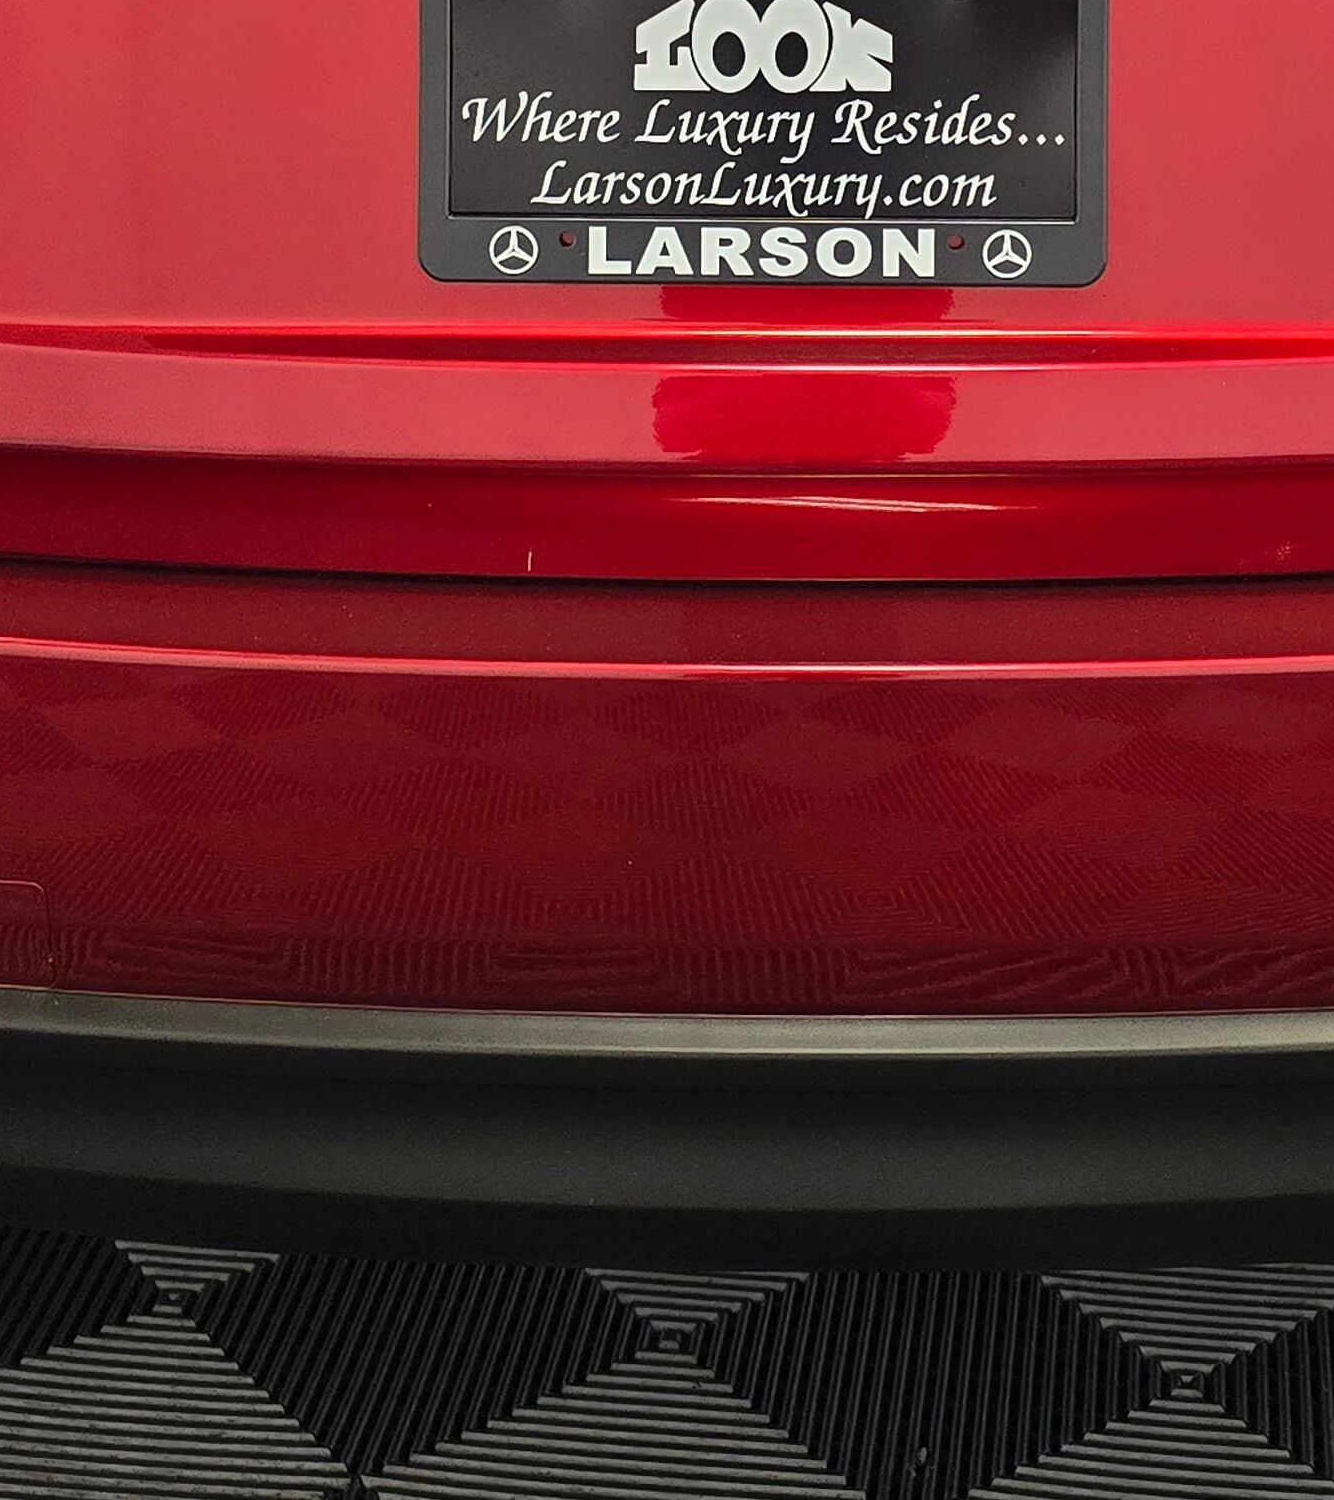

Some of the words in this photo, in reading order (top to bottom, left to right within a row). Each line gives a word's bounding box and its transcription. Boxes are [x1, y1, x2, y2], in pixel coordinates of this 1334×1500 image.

[462, 92, 622, 146] Where
[635, 99, 815, 164] Luxury
[829, 93, 1067, 155] Resides...
[530, 161, 998, 219] LarsonLuxury.com
[586, 225, 936, 278] LARSON
